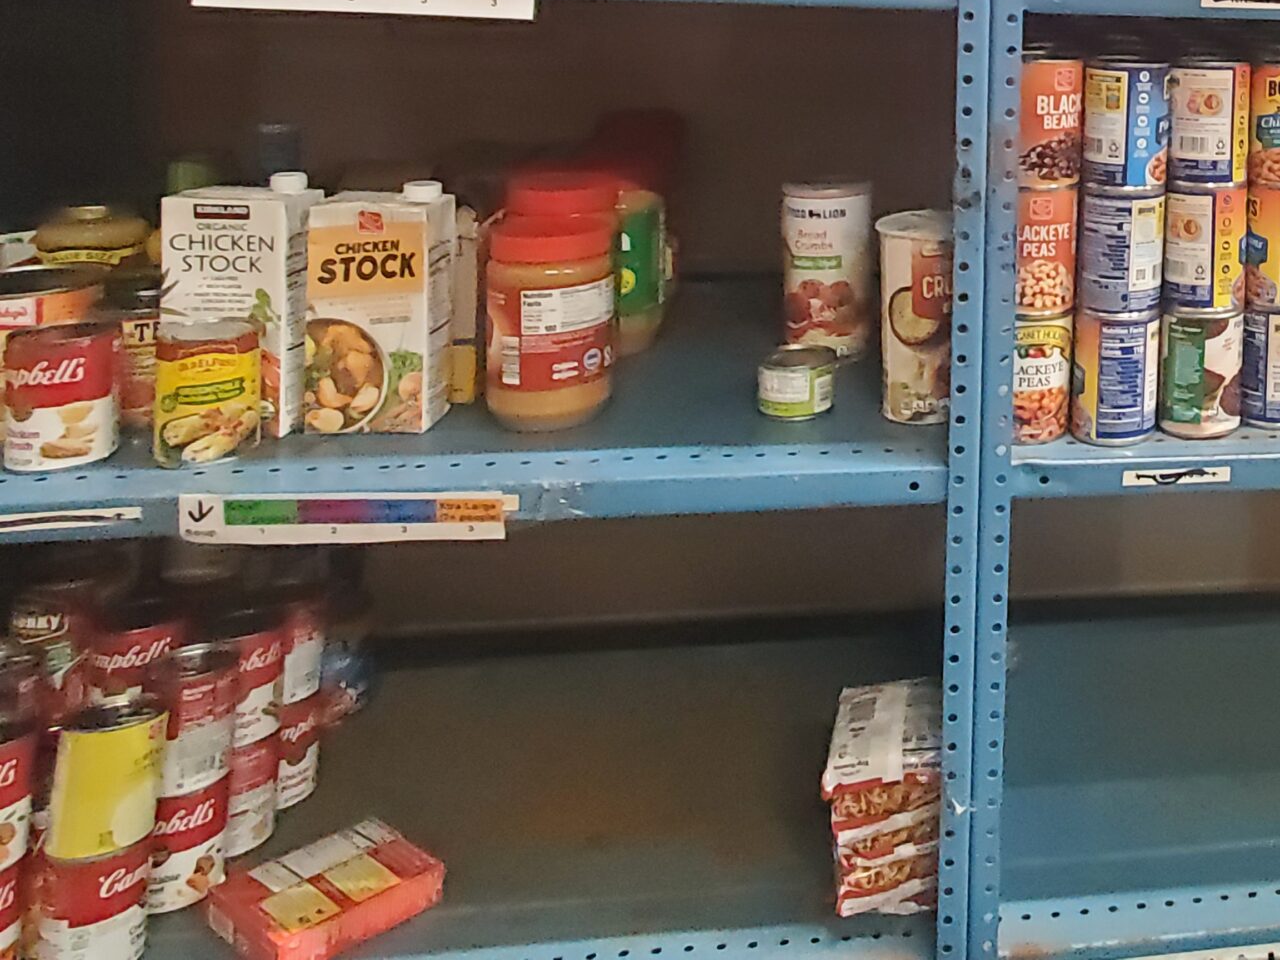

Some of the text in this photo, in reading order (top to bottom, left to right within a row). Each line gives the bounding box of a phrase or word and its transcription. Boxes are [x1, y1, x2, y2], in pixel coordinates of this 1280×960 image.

[1043, 113, 1080, 130] BEANS
[823, 208, 847, 220] LION
[797, 228, 827, 239] Bread
[1017, 222, 1071, 241] ACKEYE
[168, 233, 275, 253] CHICKEN
[334, 239, 401, 255] CHICKEN
[1022, 241, 1057, 258] PEAS
[181, 254, 263, 274] STOCK
[317, 252, 416, 285] STOCK
[1015, 360, 1065, 376] ACKEYE
[1018, 376, 1051, 388] PEAS
